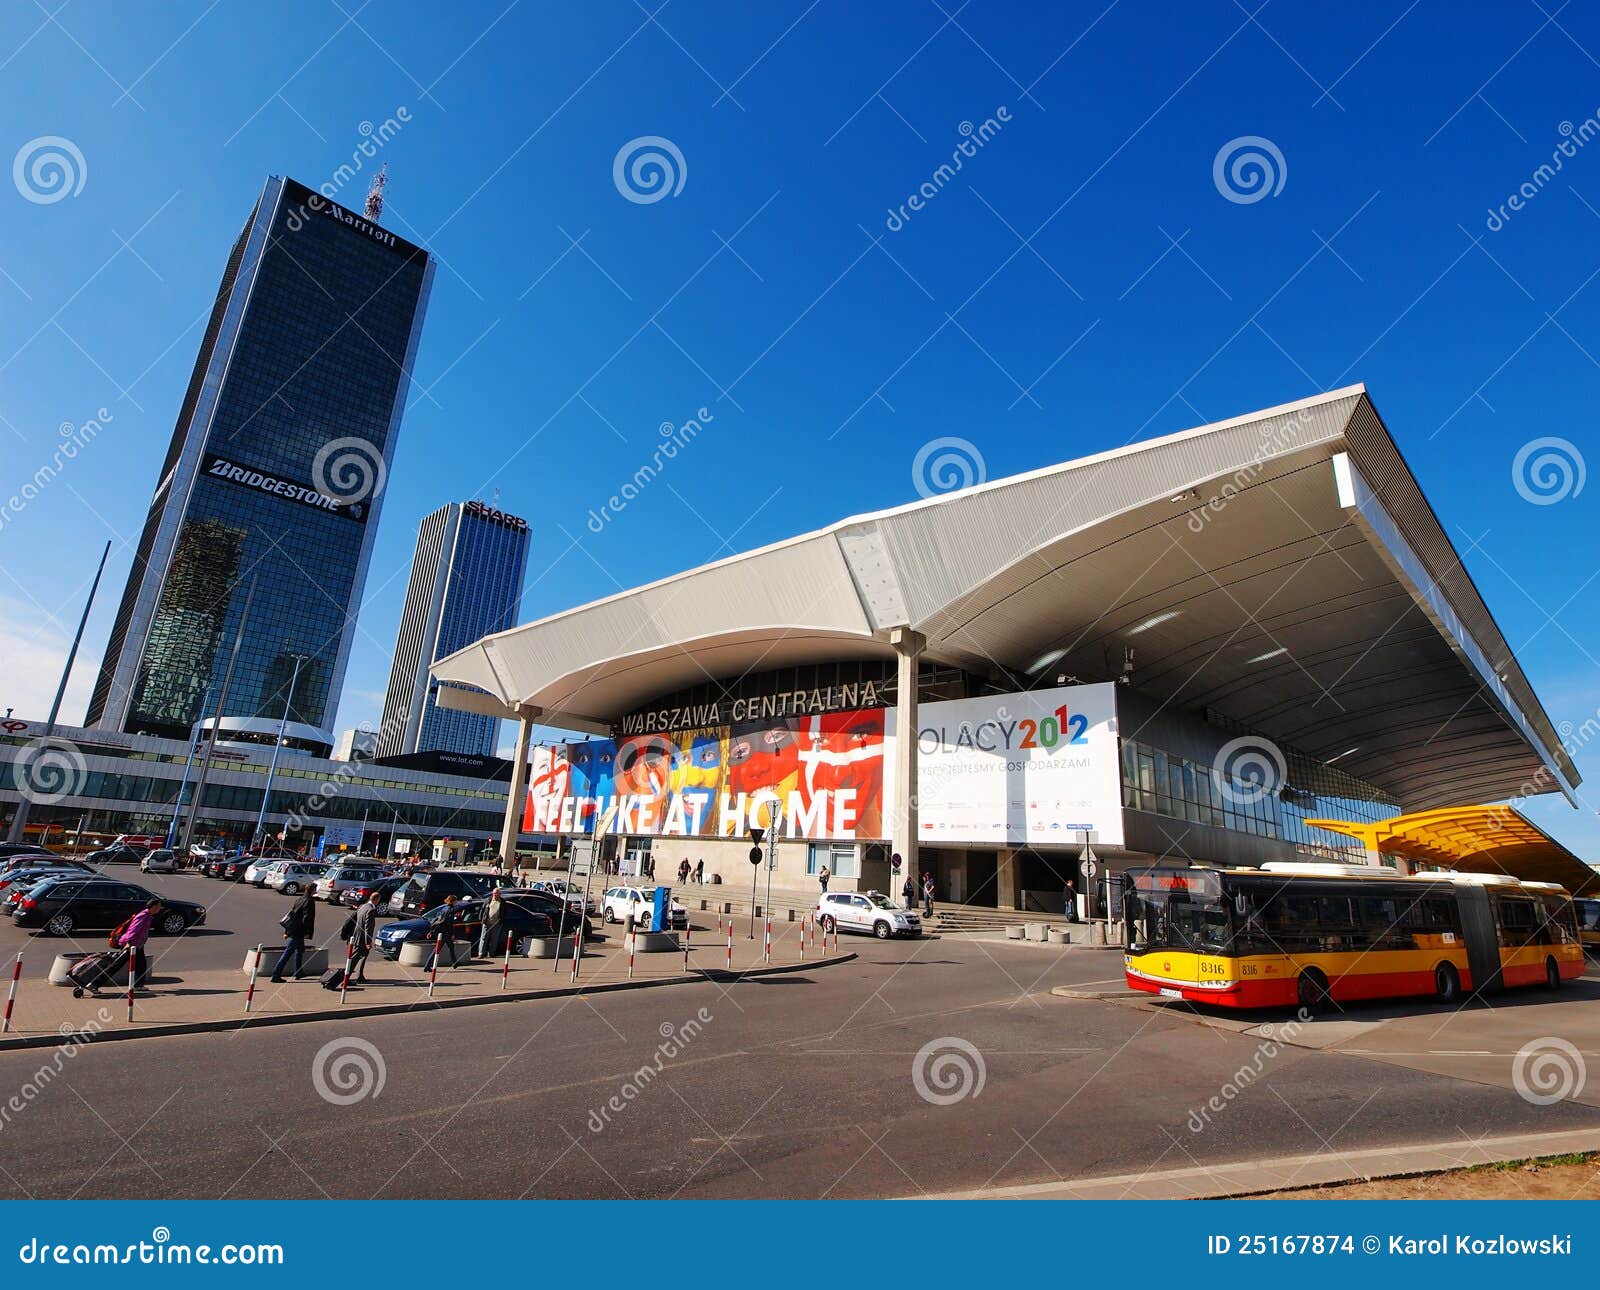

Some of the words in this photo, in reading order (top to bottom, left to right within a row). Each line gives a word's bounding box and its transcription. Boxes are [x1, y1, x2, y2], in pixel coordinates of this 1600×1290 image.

[324, 204, 396, 248] Marriott
[208, 459, 342, 511] BRIDGESTONE
[467, 501, 527, 529] SHARP
[622, 702, 720, 734] WARSZAWA
[732, 680, 879, 721] CENTRALNA
[662, 793, 709, 836] AT
[718, 788, 857, 840] HOME
[1201, 962, 1225, 975] 8316
[1242, 965, 1258, 976] 8316
